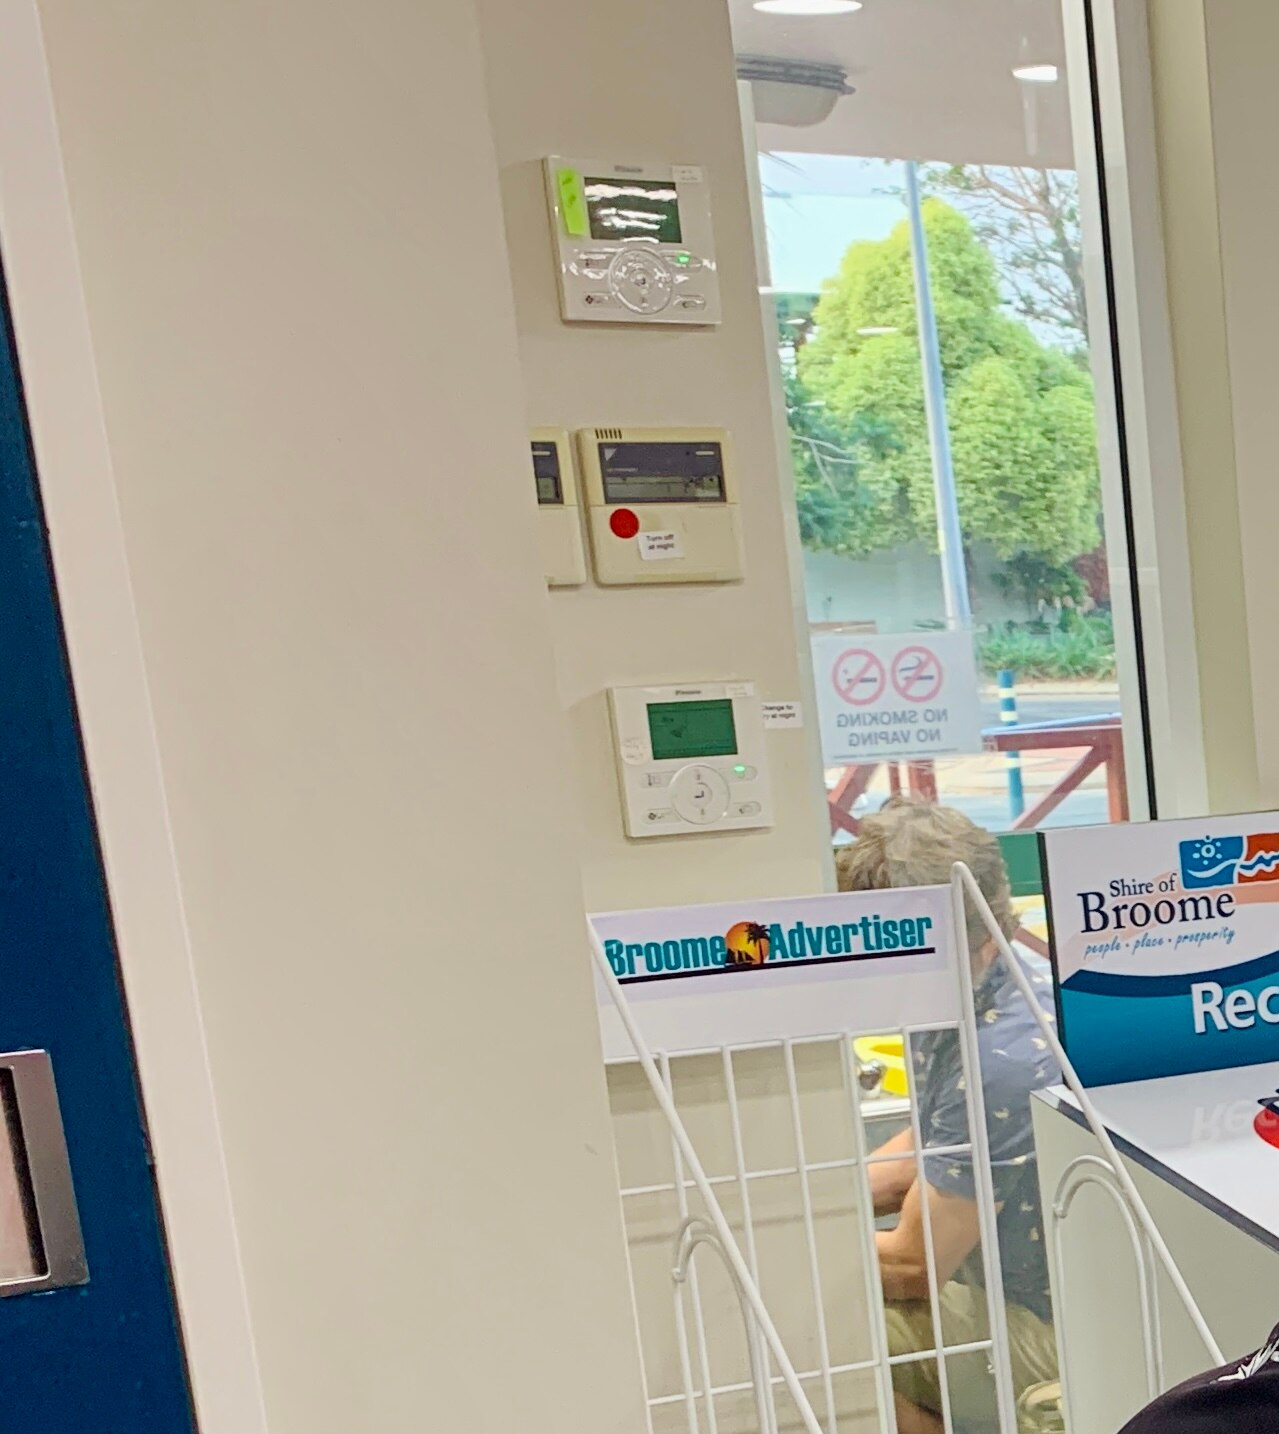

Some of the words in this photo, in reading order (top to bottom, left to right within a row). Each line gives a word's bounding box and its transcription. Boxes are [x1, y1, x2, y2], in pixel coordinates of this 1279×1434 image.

[1109, 876, 1154, 899] Shire
[1158, 872, 1177, 894] of
[1077, 887, 1236, 935] Broome
[603, 934, 727, 976] Broome
[768, 914, 933, 961] Advertiser
[1084, 936, 1122, 959] people
[1133, 933, 1165, 952] place
[1175, 926, 1236, 949] prosperity
